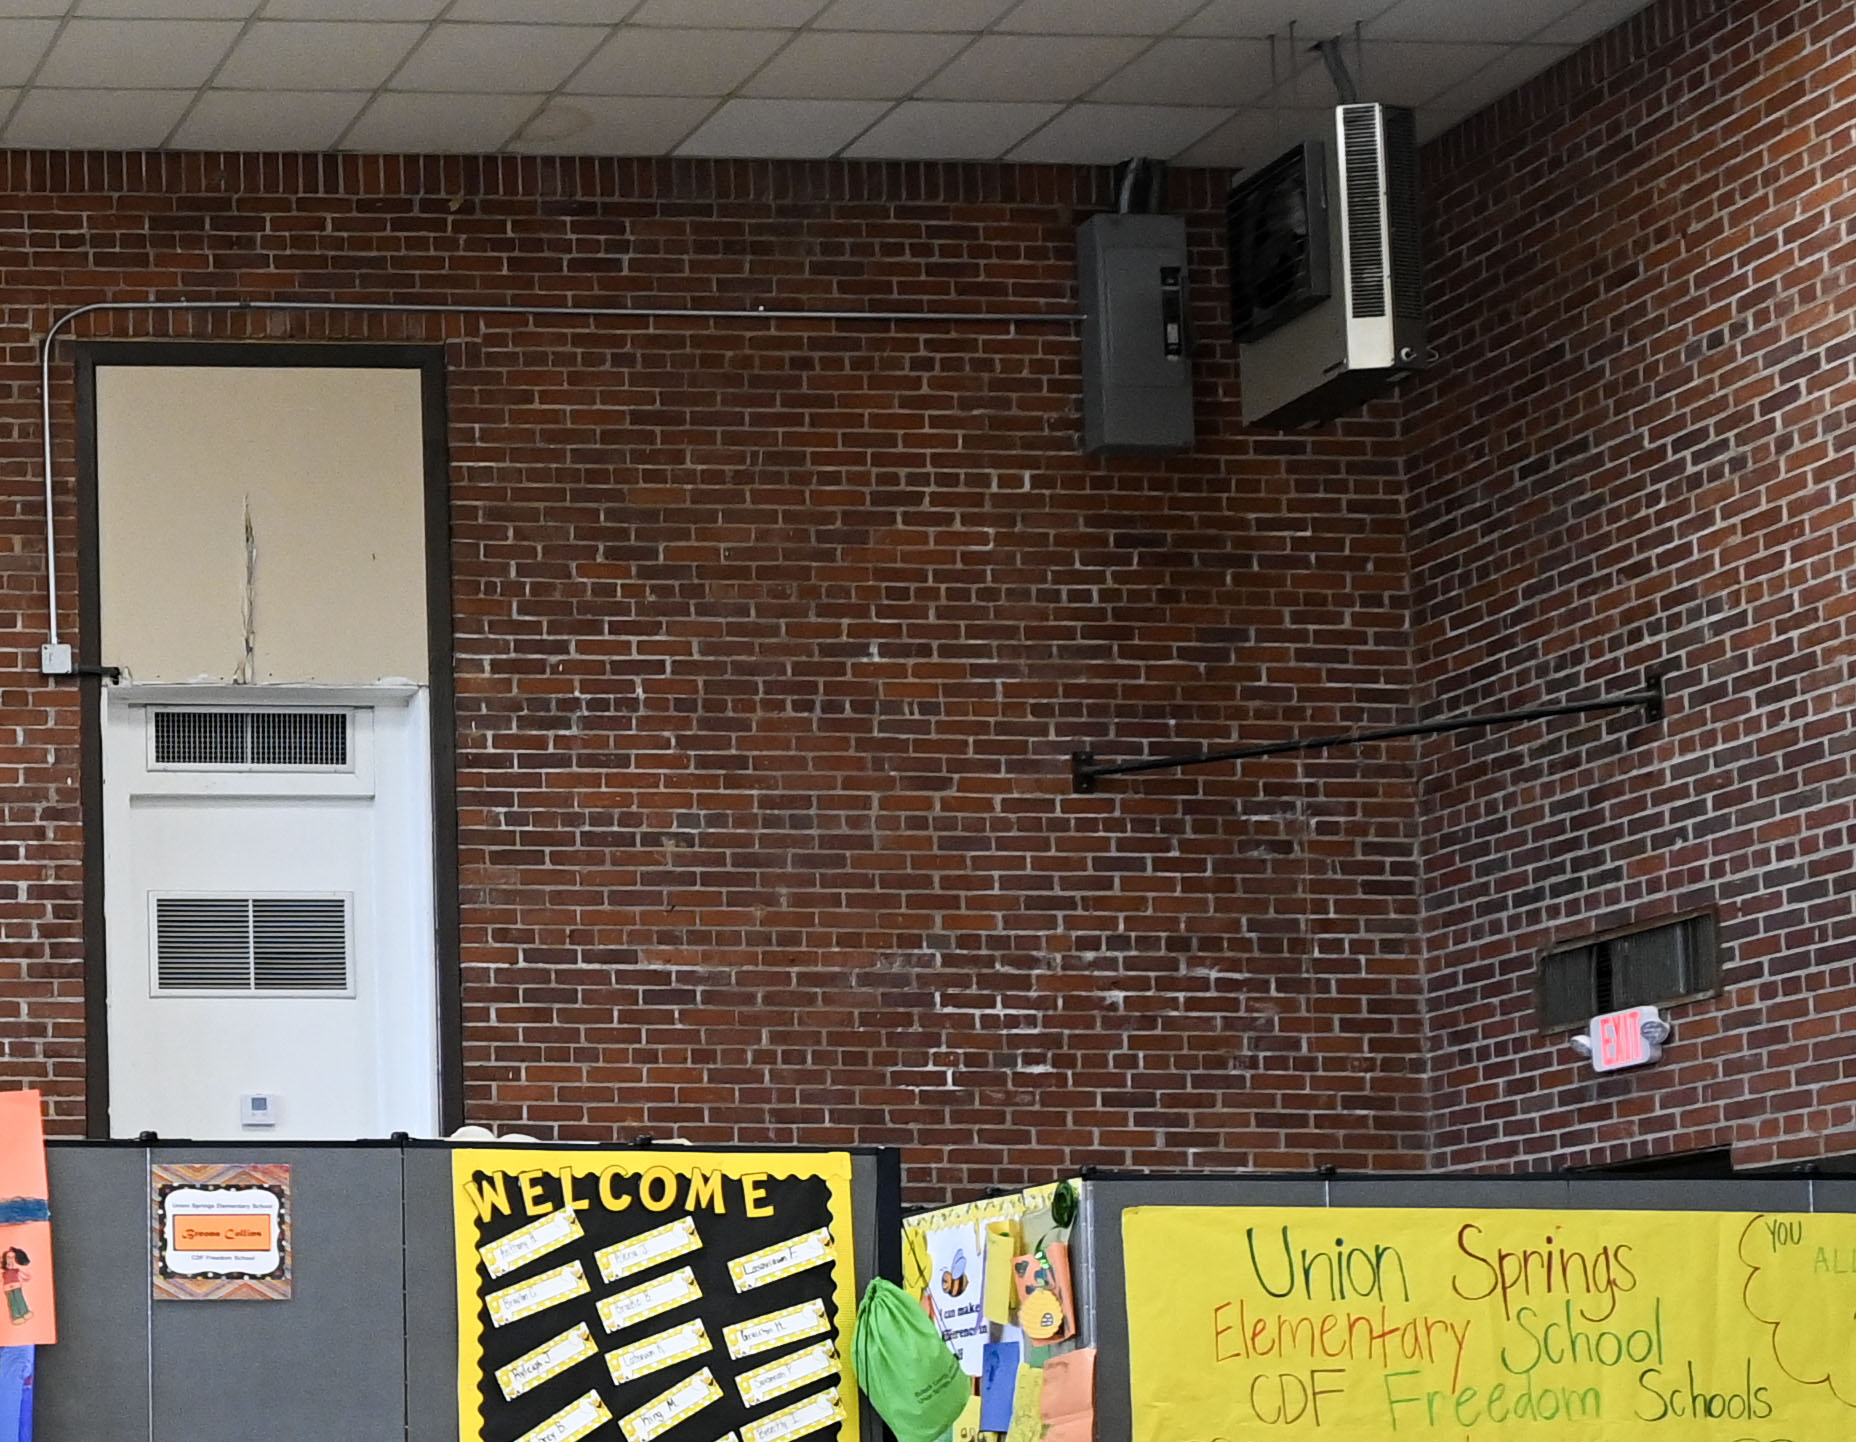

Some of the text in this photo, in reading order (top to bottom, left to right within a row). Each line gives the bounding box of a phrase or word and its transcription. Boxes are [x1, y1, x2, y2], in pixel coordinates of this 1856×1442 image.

[1600, 1011, 1643, 1067] EXIT
[463, 1164, 774, 1223] WELCOME
[1765, 1219, 1802, 1253] YOU
[1245, 1223, 1637, 1323] Union Springs
[957, 1302, 981, 1316] make
[1214, 1297, 1664, 1395] Elementary School
[1250, 1357, 1773, 1432] CDF Freedom Schools
